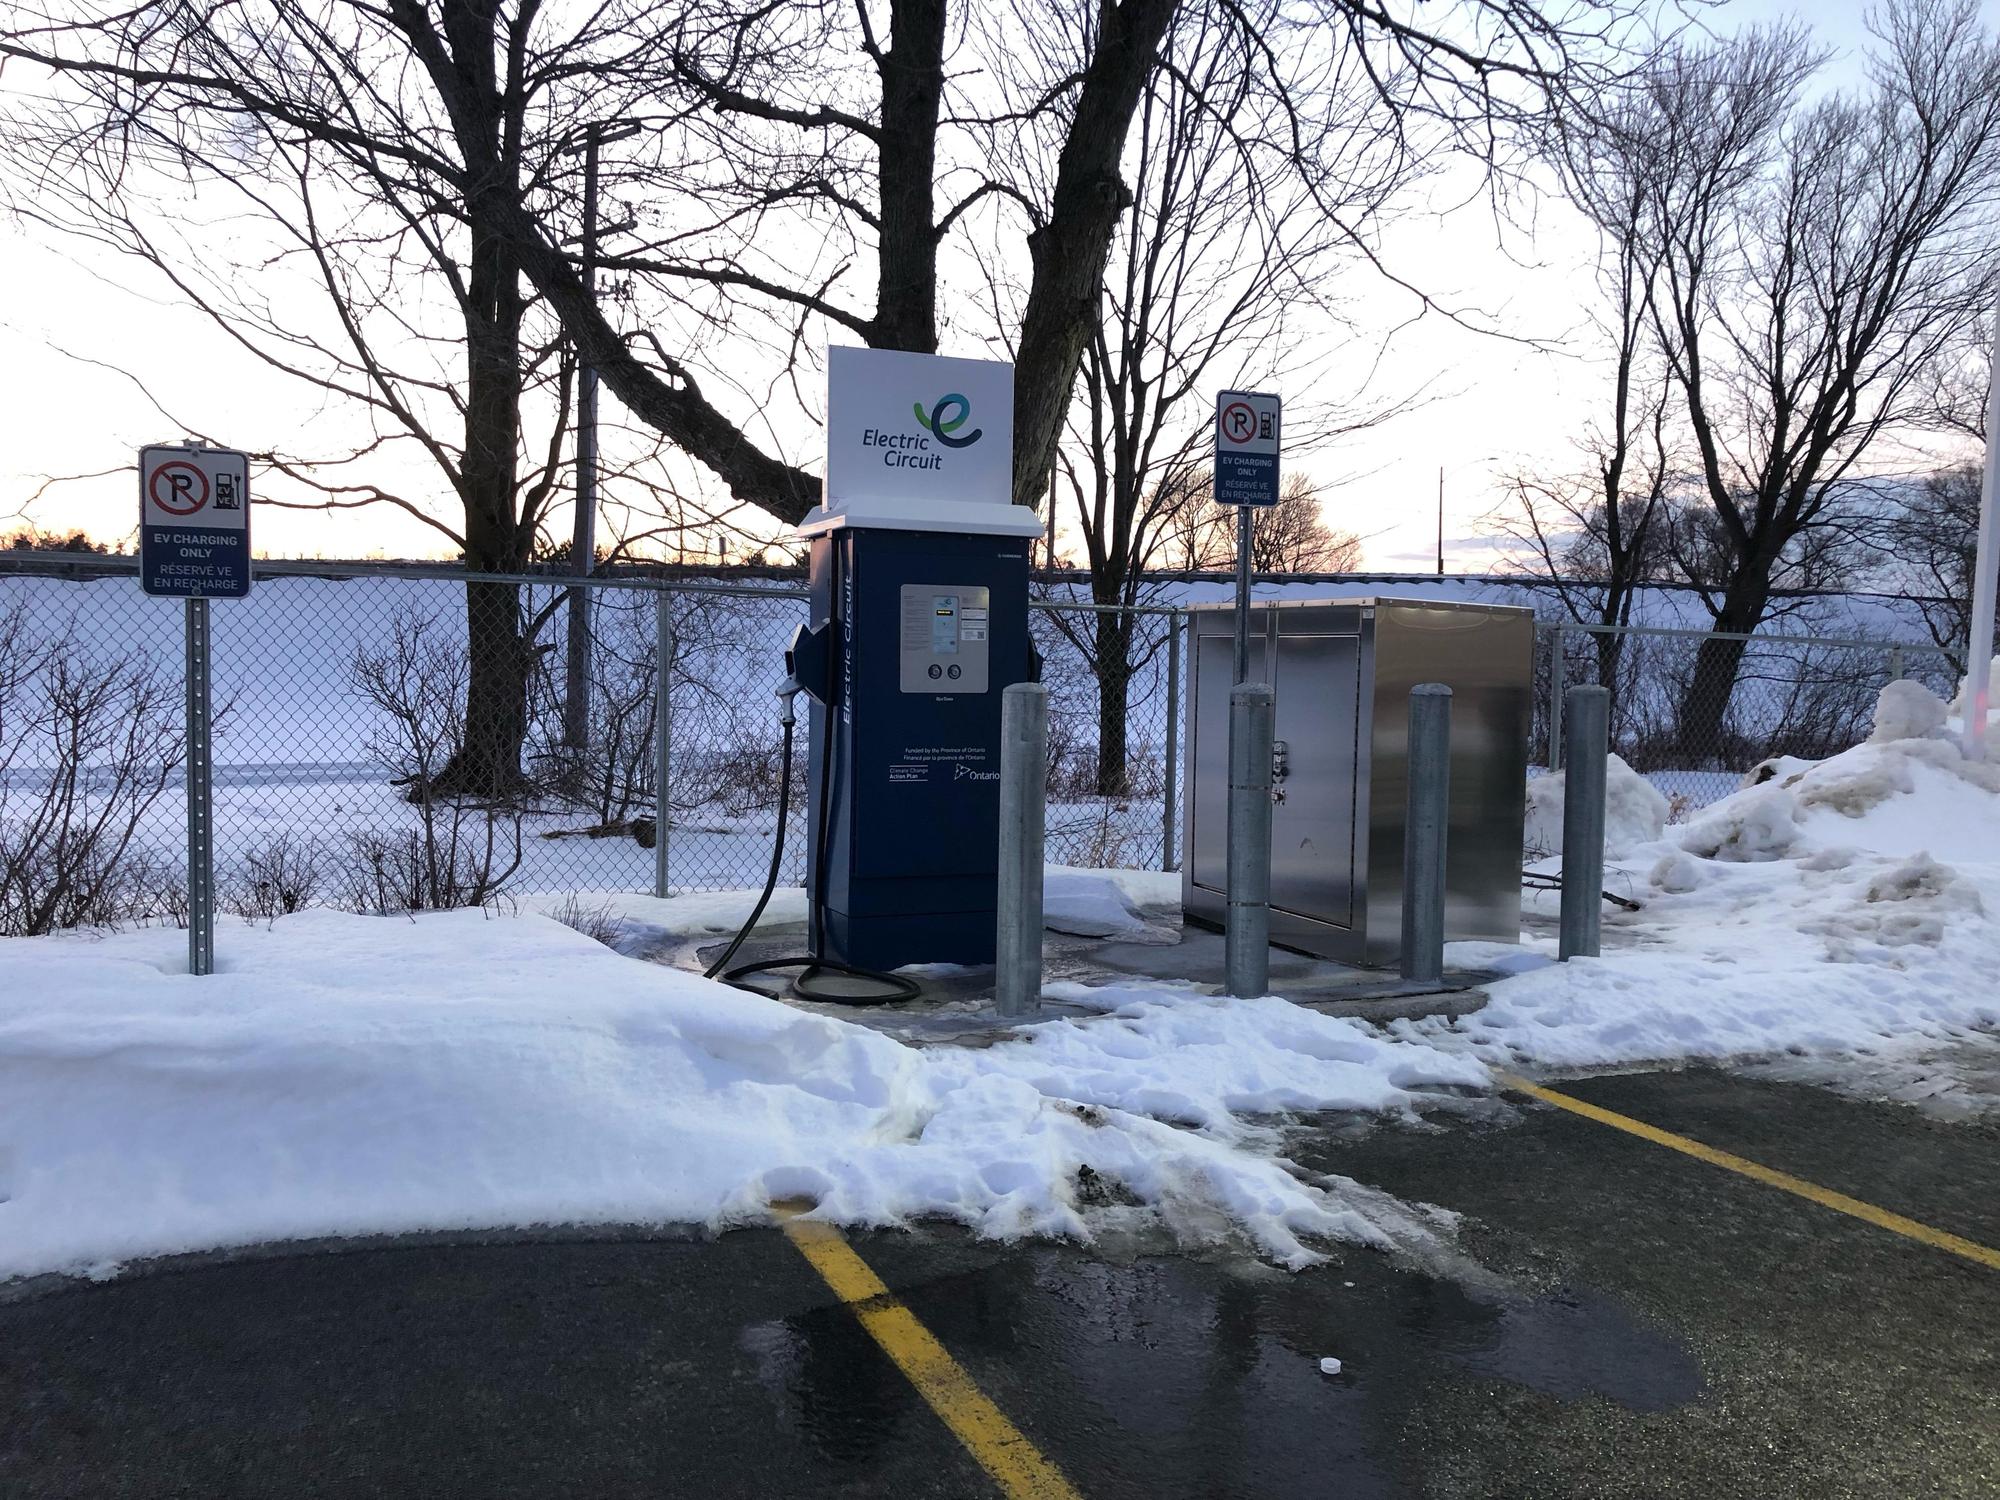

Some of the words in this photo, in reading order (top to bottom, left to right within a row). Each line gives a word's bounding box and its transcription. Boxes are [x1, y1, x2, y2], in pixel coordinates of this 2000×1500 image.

[1261, 421, 1270, 429] EV
[862, 428, 930, 451] Electric
[884, 450, 943, 470] Circuit
[1222, 456, 1232, 465] EV
[1234, 457, 1273, 467] CHARGING
[1237, 467, 1257, 476] ONLY
[217, 486, 230, 495] EV
[1259, 482, 1269, 490] VE
[218, 496, 231, 505] VE
[1221, 490, 1232, 498] EN
[1233, 490, 1272, 500] RECHARGE
[154, 533, 170, 543] EV
[173, 534, 238, 546] CHARGING
[180, 547, 213, 558] ONLY
[160, 562, 214, 576] RÉSERVÉ
[217, 566, 232, 576] VE
[154, 577, 172, 588] EN
[174, 578, 239, 590] RECHARGE
[844, 575, 852, 642] Circuit
[843, 648, 851, 725] Electric
[969, 771, 1000, 780] Ontario
